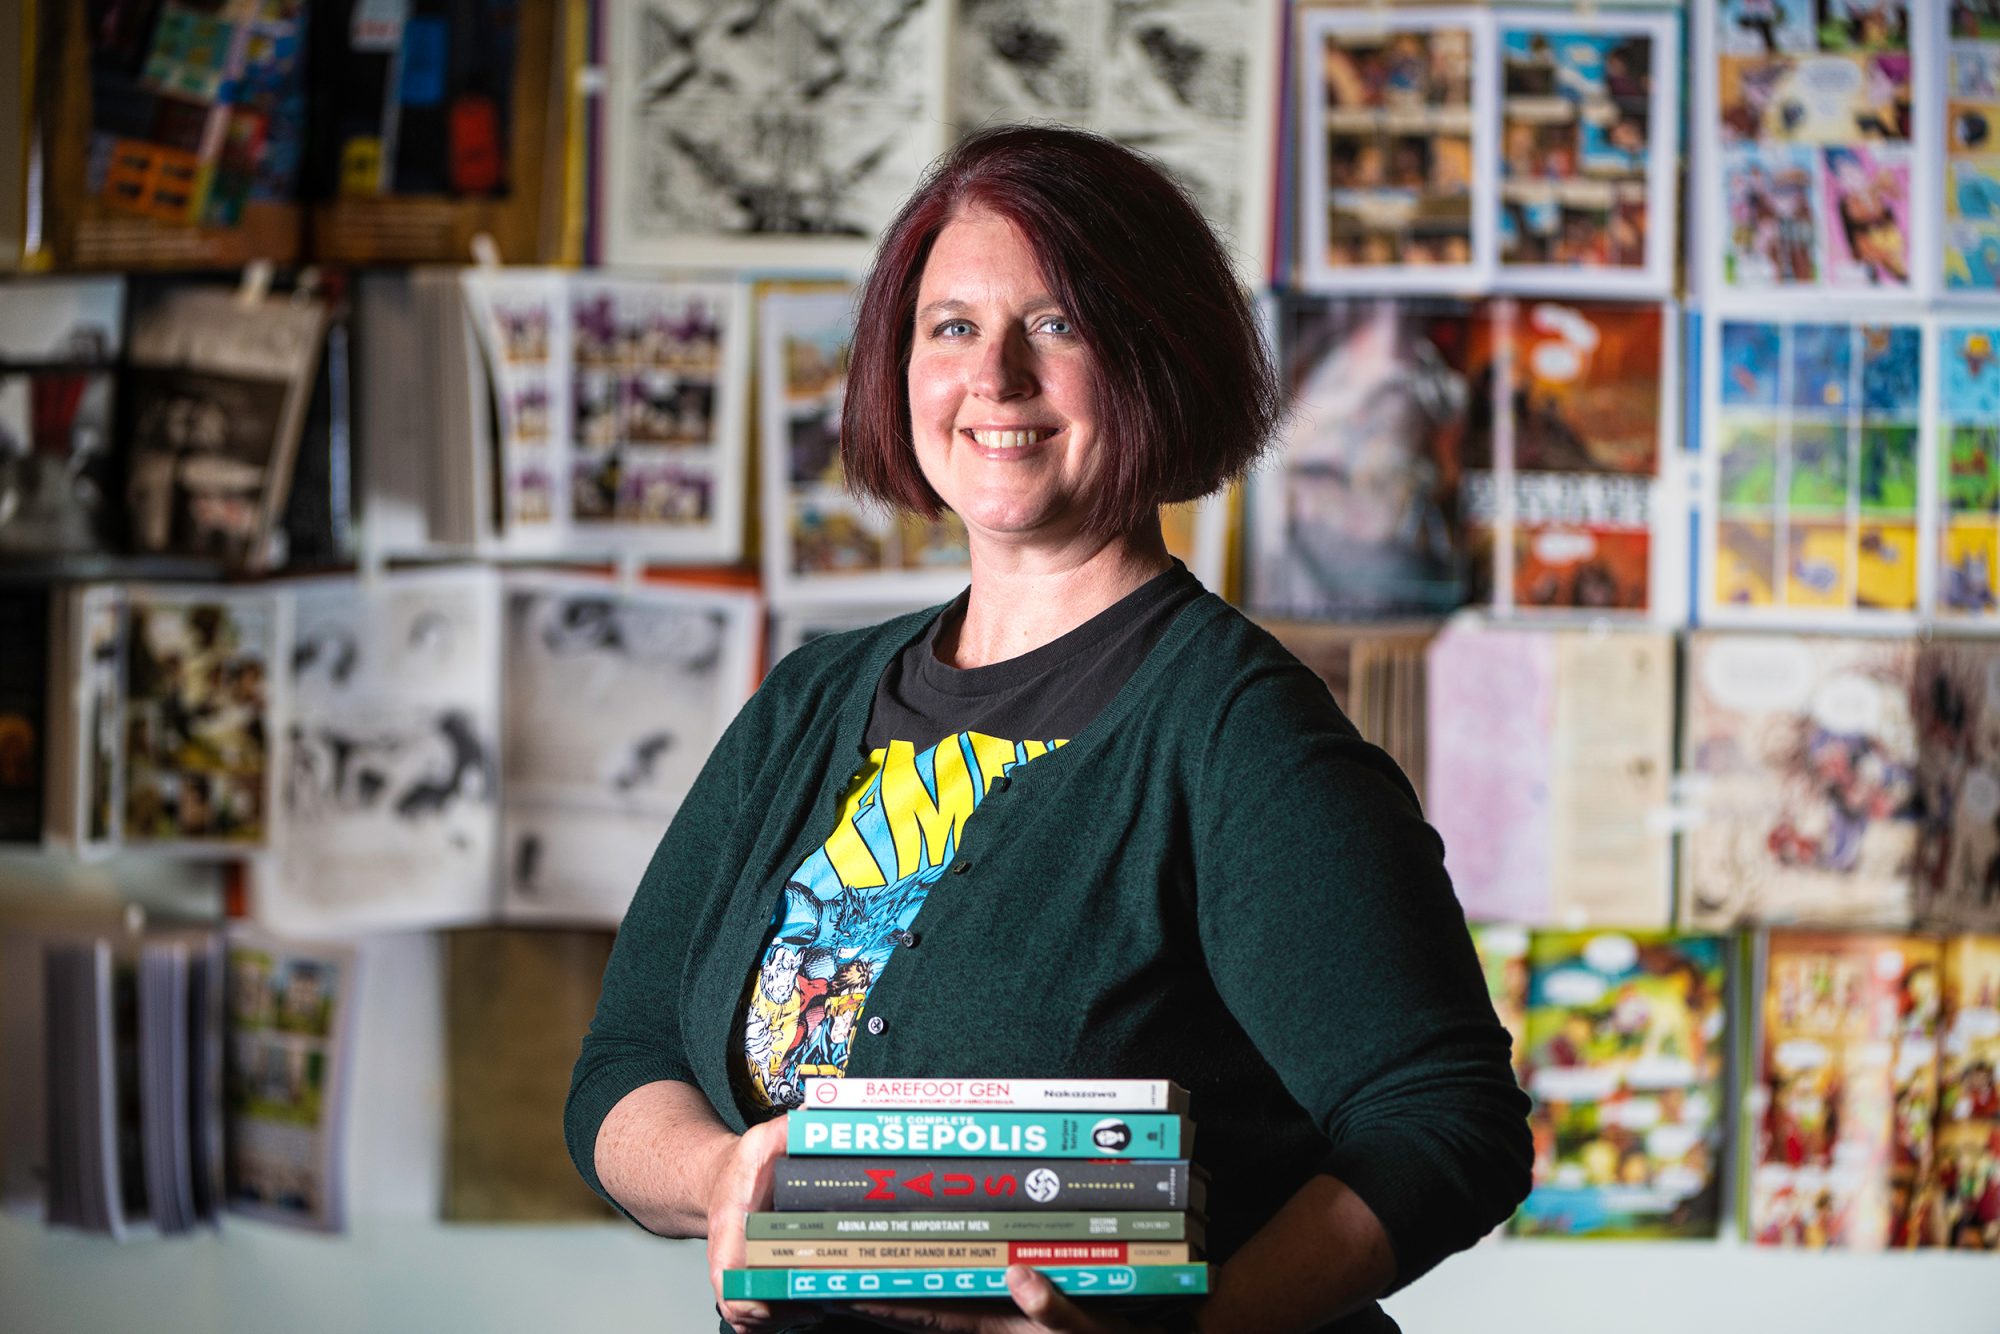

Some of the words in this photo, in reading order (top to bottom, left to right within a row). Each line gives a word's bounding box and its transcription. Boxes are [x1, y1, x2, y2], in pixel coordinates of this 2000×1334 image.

[866, 1082, 964, 1096] BAREFOOT
[969, 1082, 1010, 1097] GEN
[1044, 1089, 1117, 1098] Nakazawa
[876, 1115, 902, 1125] THE
[906, 1115, 975, 1126] COMPLETE
[804, 1122, 1047, 1152] PERSEPOLIS
[863, 1169, 1018, 1201] MAUS
[837, 1220, 867, 1232] ABINA
[868, 1220, 889, 1232] AND
[891, 1220, 909, 1232] THE
[911, 1220, 966, 1232] IMPORTANT
[967, 1220, 990, 1232] MEN
[771, 1247, 795, 1257] VANN
[816, 1247, 848, 1257] CLARKE
[859, 1247, 876, 1257] THE
[880, 1247, 910, 1257] GREAT
[947, 1247, 967, 1258] RAT
[970, 1247, 997, 1258] HUNT
[1016, 1247, 1052, 1258] GRAPHIC
[1091, 1247, 1119, 1258] SERIES
[795, 1272, 1129, 1291] RADIOACIVE
